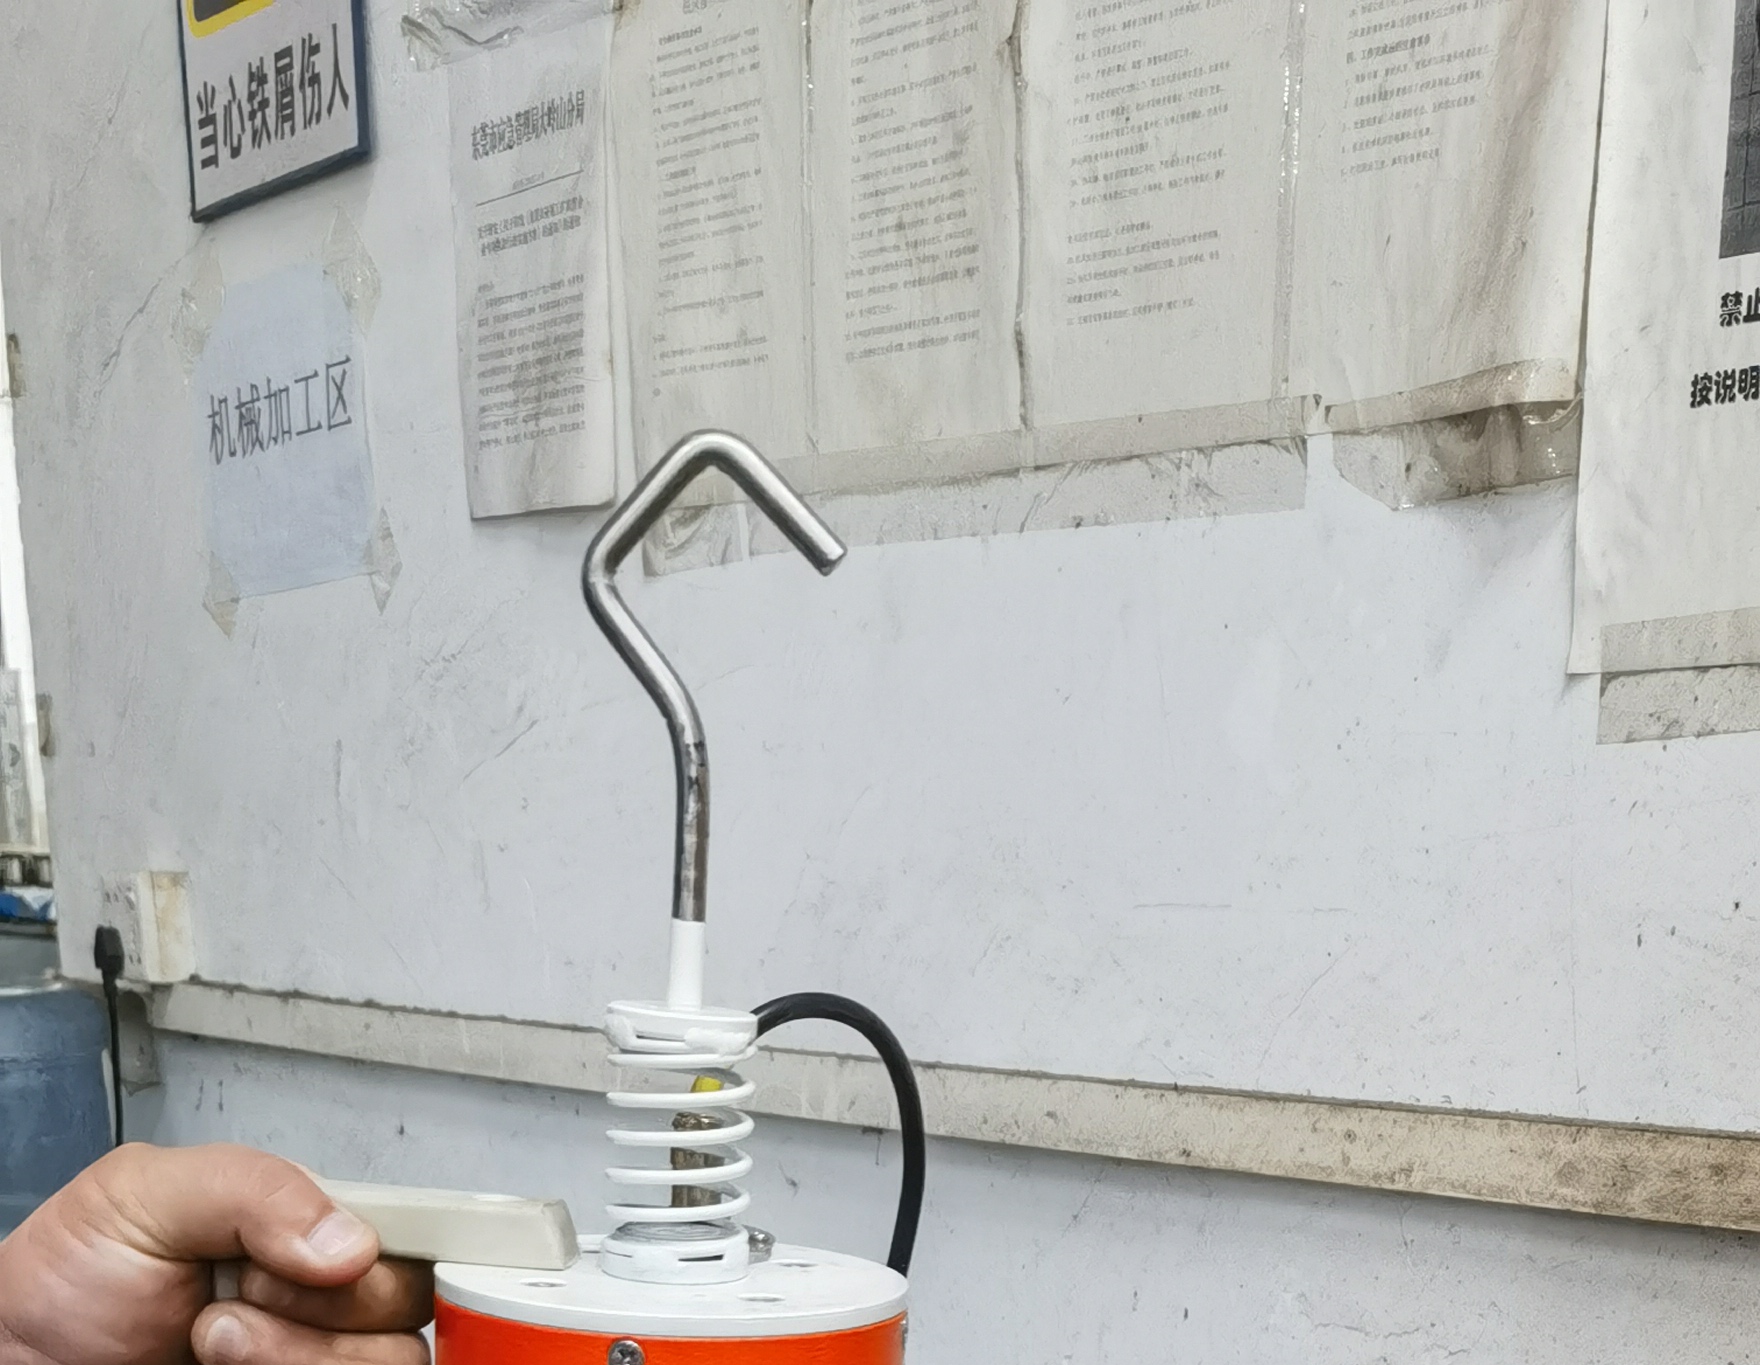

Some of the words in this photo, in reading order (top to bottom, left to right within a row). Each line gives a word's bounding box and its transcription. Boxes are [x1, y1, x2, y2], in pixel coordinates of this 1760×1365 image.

[197, 23, 349, 170] 当心铁屑伤人
[207, 355, 352, 465] 机械加工区
[1690, 365, 1760, 408] 按说明
